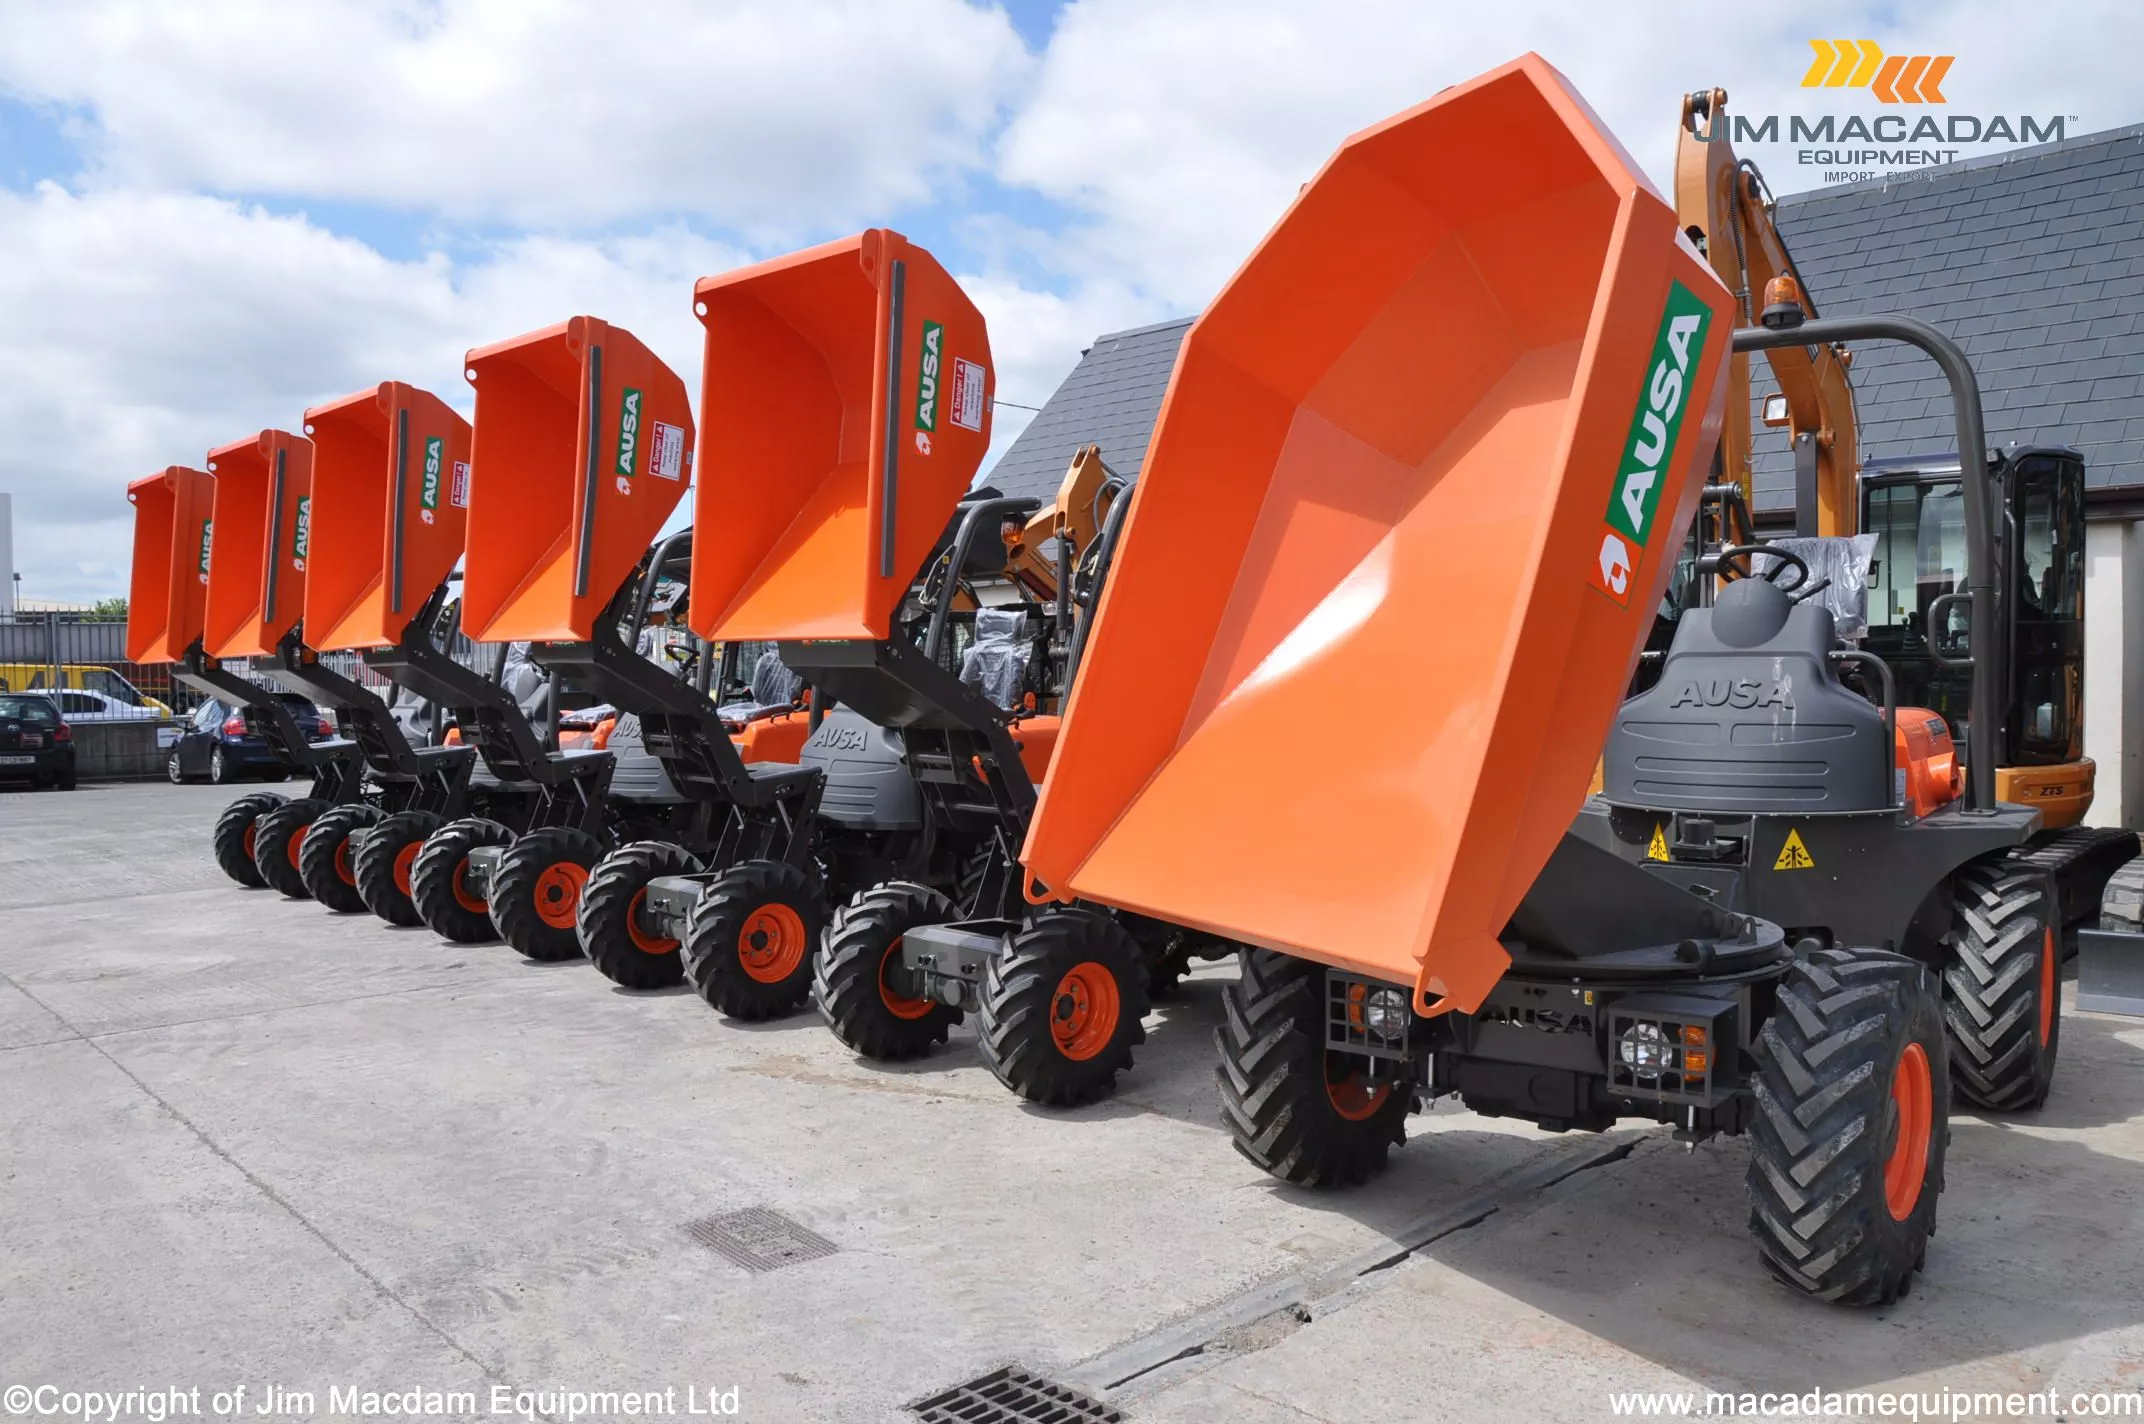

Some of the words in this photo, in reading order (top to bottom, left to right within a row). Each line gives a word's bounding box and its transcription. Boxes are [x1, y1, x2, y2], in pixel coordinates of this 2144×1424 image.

[919, 327, 940, 430] AUSA
[619, 392, 639, 474] AUSA
[1621, 314, 1701, 535] AUSA
[424, 440, 440, 507] AUSA
[296, 499, 311, 557] AUSA
[1669, 677, 1795, 709] AUSA
[612, 719, 643, 739] AUS
[811, 727, 869, 752] AUSA
[1478, 1003, 1593, 1037] AUSA
